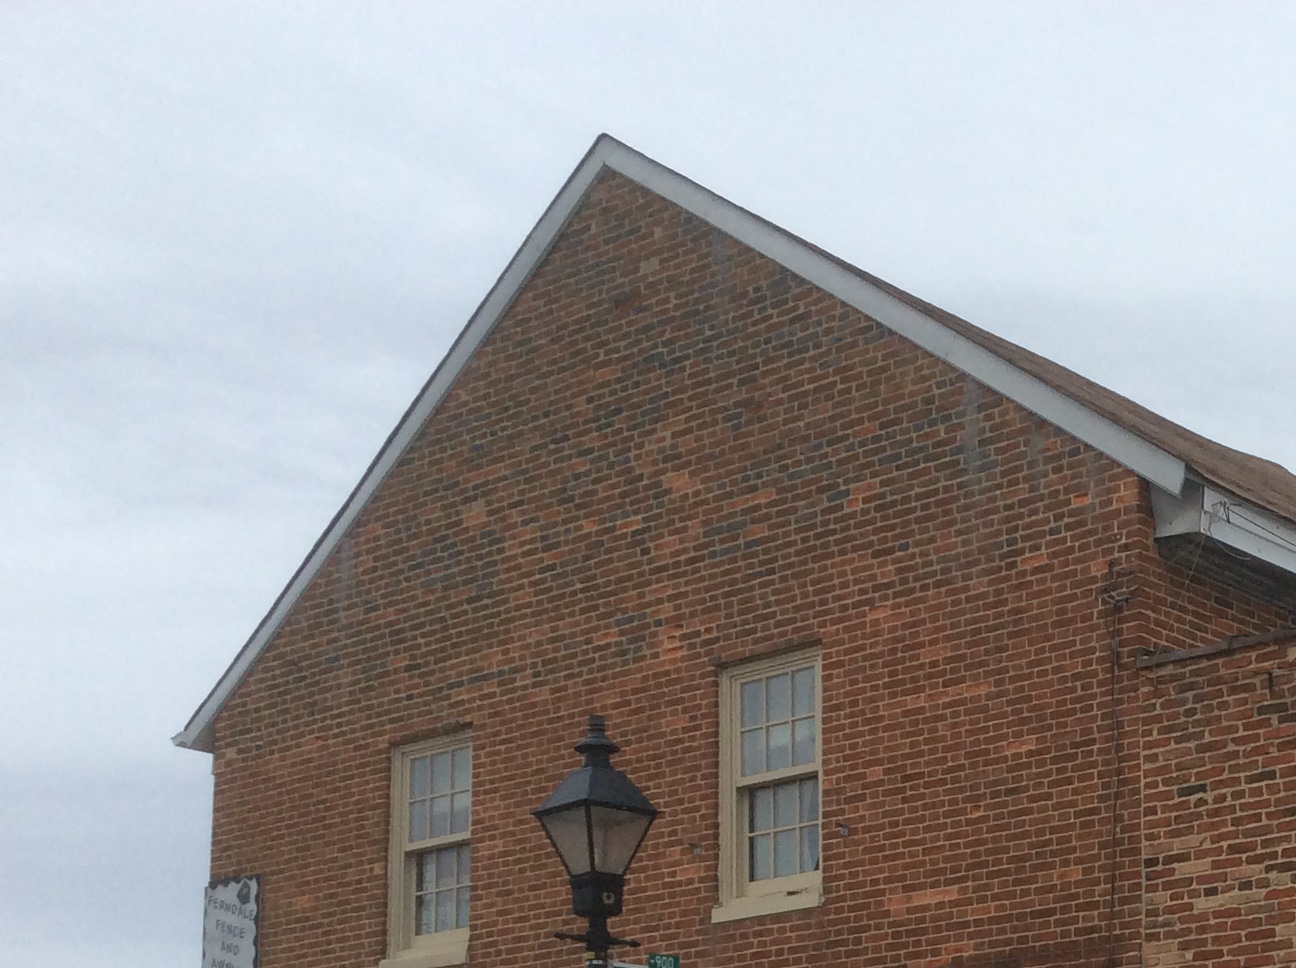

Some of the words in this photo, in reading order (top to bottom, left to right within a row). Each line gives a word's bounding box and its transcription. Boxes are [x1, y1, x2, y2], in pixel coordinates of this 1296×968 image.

[208, 896, 254, 920] FERNDALE
[216, 919, 245, 939] FENCE
[220, 941, 239, 956] AND
